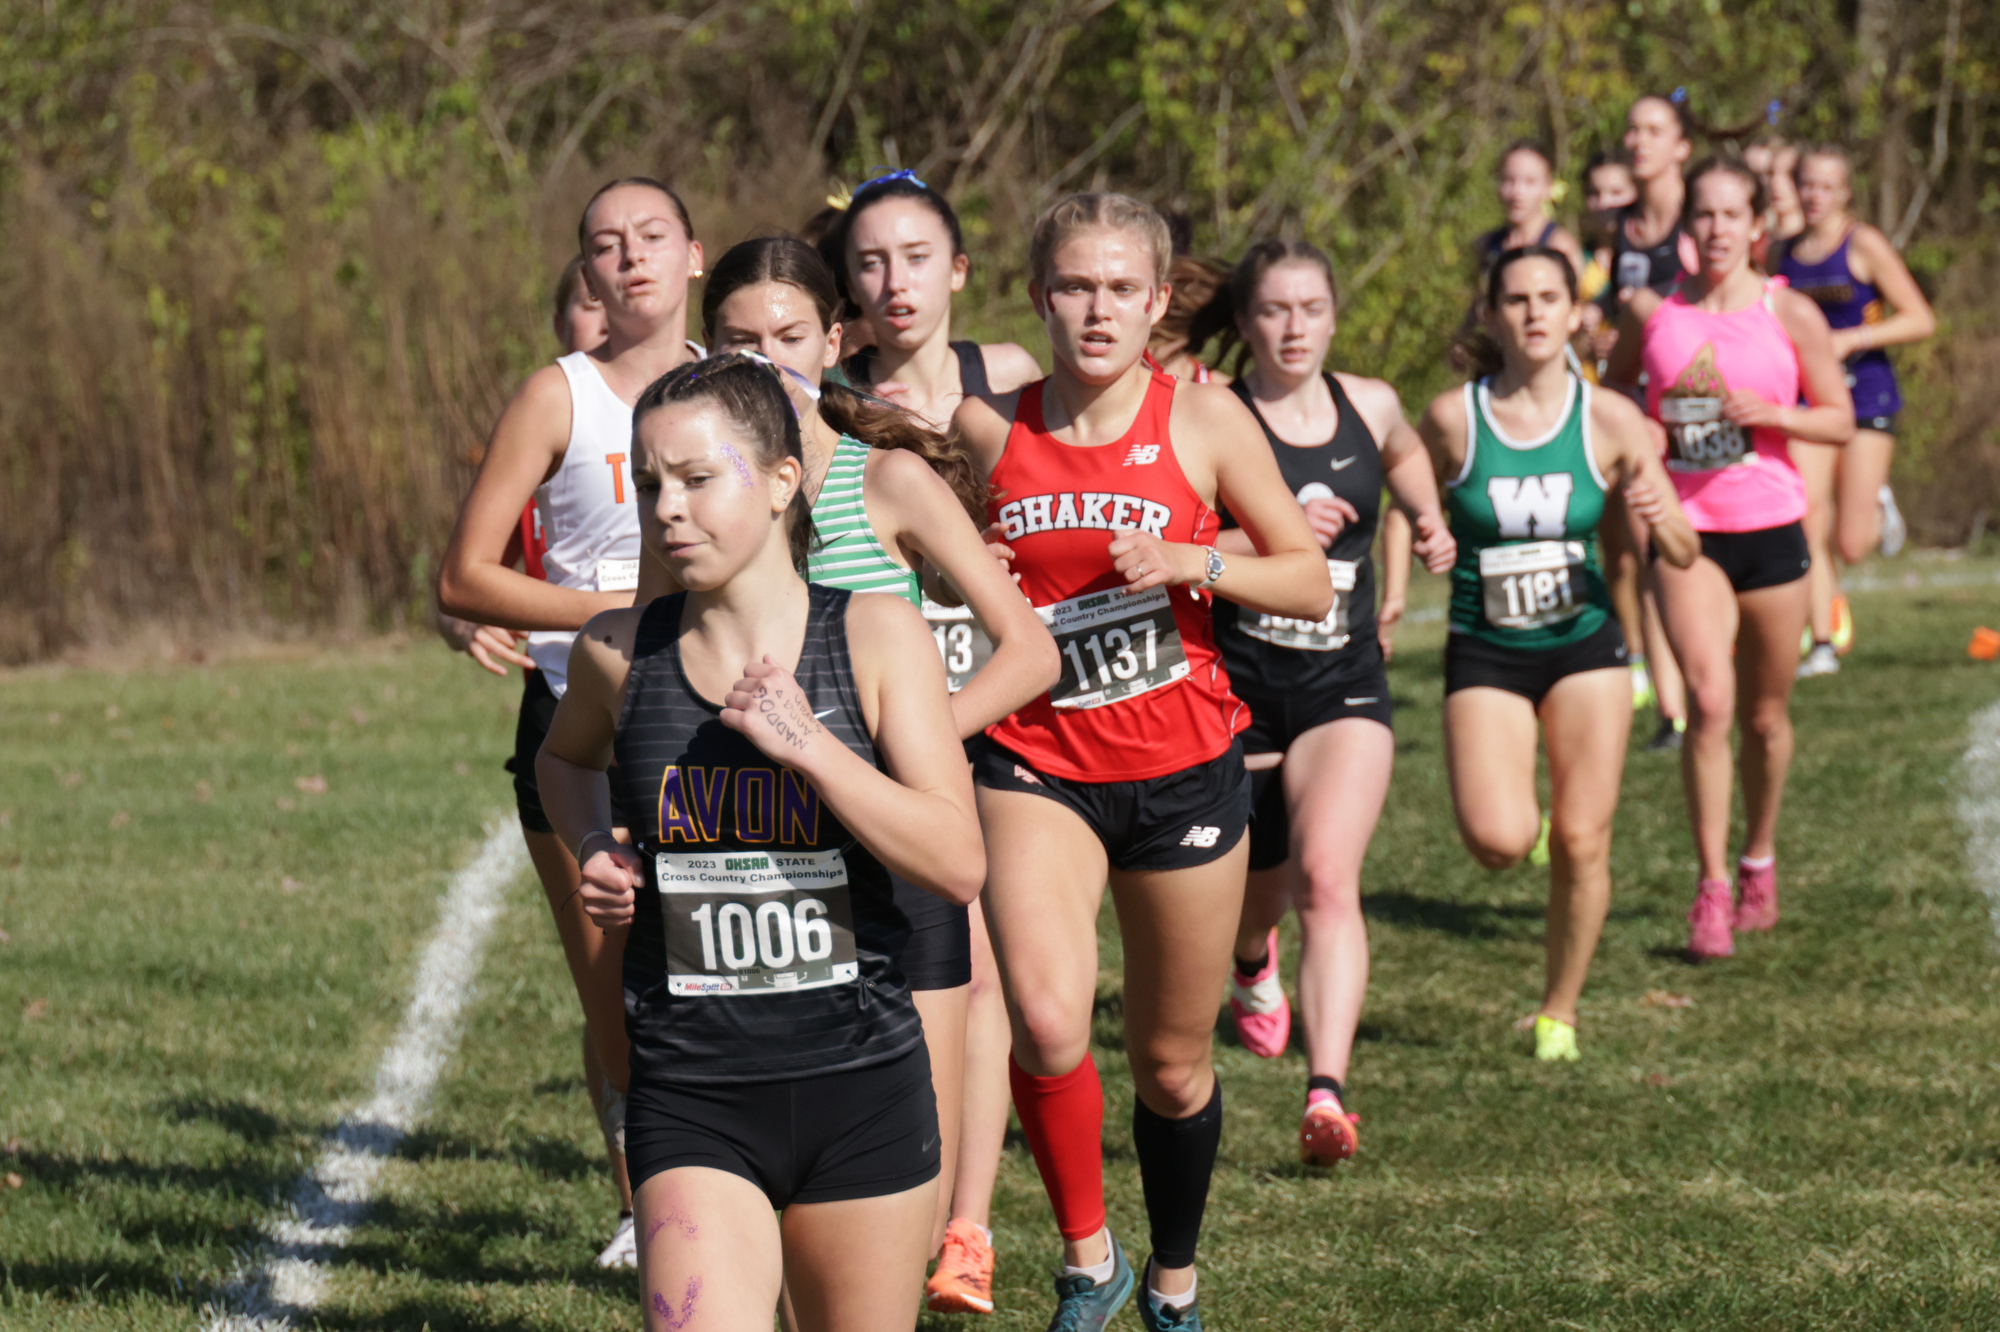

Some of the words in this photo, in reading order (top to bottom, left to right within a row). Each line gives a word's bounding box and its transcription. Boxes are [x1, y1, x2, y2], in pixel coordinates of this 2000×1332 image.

[998, 491, 1172, 541] SHAKER
[1487, 471, 1574, 538] W
[1050, 605, 1072, 617] 2023
[1060, 612, 1095, 626] Country
[1097, 592, 1166, 616] Championships
[1502, 567, 1572, 617] 1181
[1062, 618, 1158, 692] 1137
[752, 685, 808, 750] MADDOG
[658, 765, 820, 846] AVON
[661, 872, 696, 881] Cross
[699, 871, 746, 883] Country
[750, 868, 844, 883] Championships
[687, 860, 717, 869] 2023
[724, 857, 770, 871] OHSAA
[776, 857, 816, 867] STATE
[690, 898, 833, 971] 1006
[684, 982, 720, 992] MileSplit
